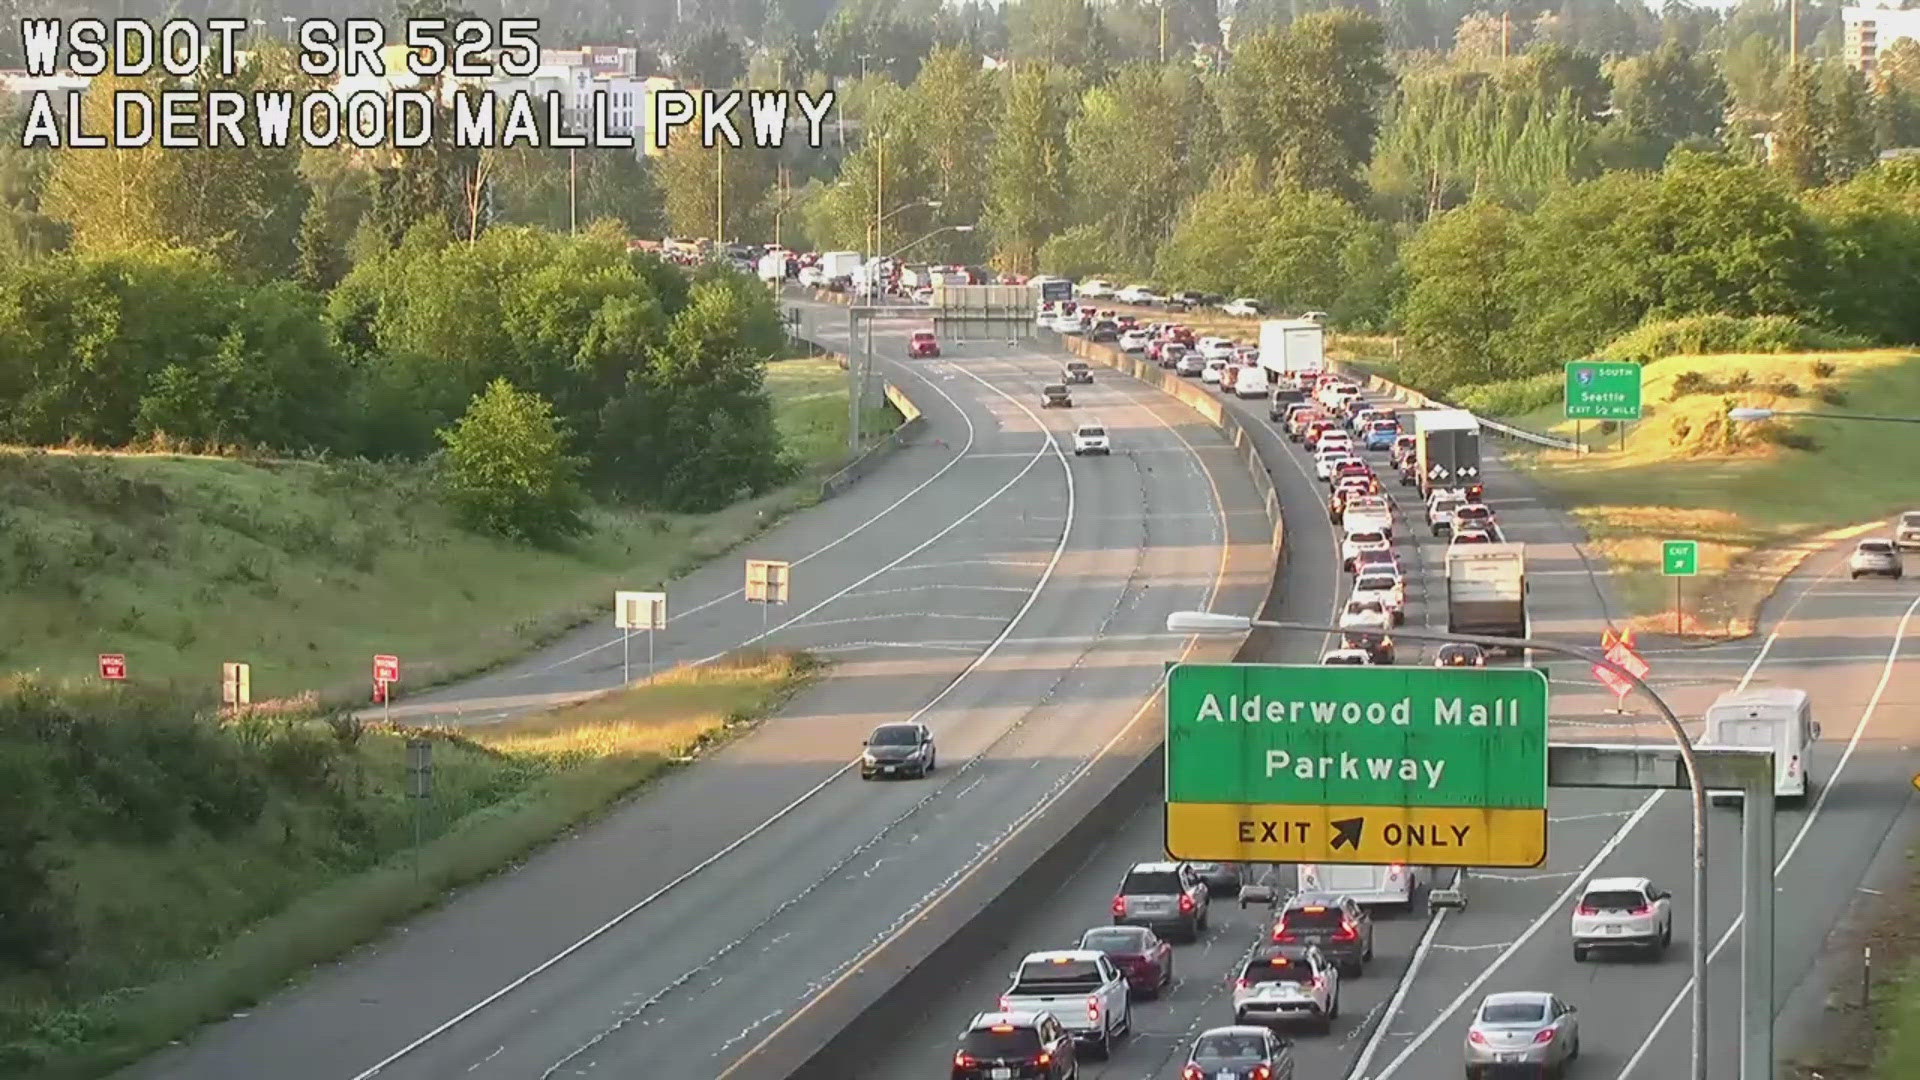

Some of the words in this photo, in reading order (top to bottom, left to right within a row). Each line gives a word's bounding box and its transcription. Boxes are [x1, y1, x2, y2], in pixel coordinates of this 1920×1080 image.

[1598, 368, 1633, 377] SOUTH
[1580, 392, 1625, 402] Seattle
[1568, 406, 1590, 414] EXIT
[1611, 406, 1636, 415] MILE
[1195, 692, 1411, 726] Alderwood
[1434, 696, 1519, 728] Mall
[1265, 748, 1446, 790] Parkway
[1237, 819, 1312, 845] EXIT
[1382, 822, 1471, 848] ONLY
